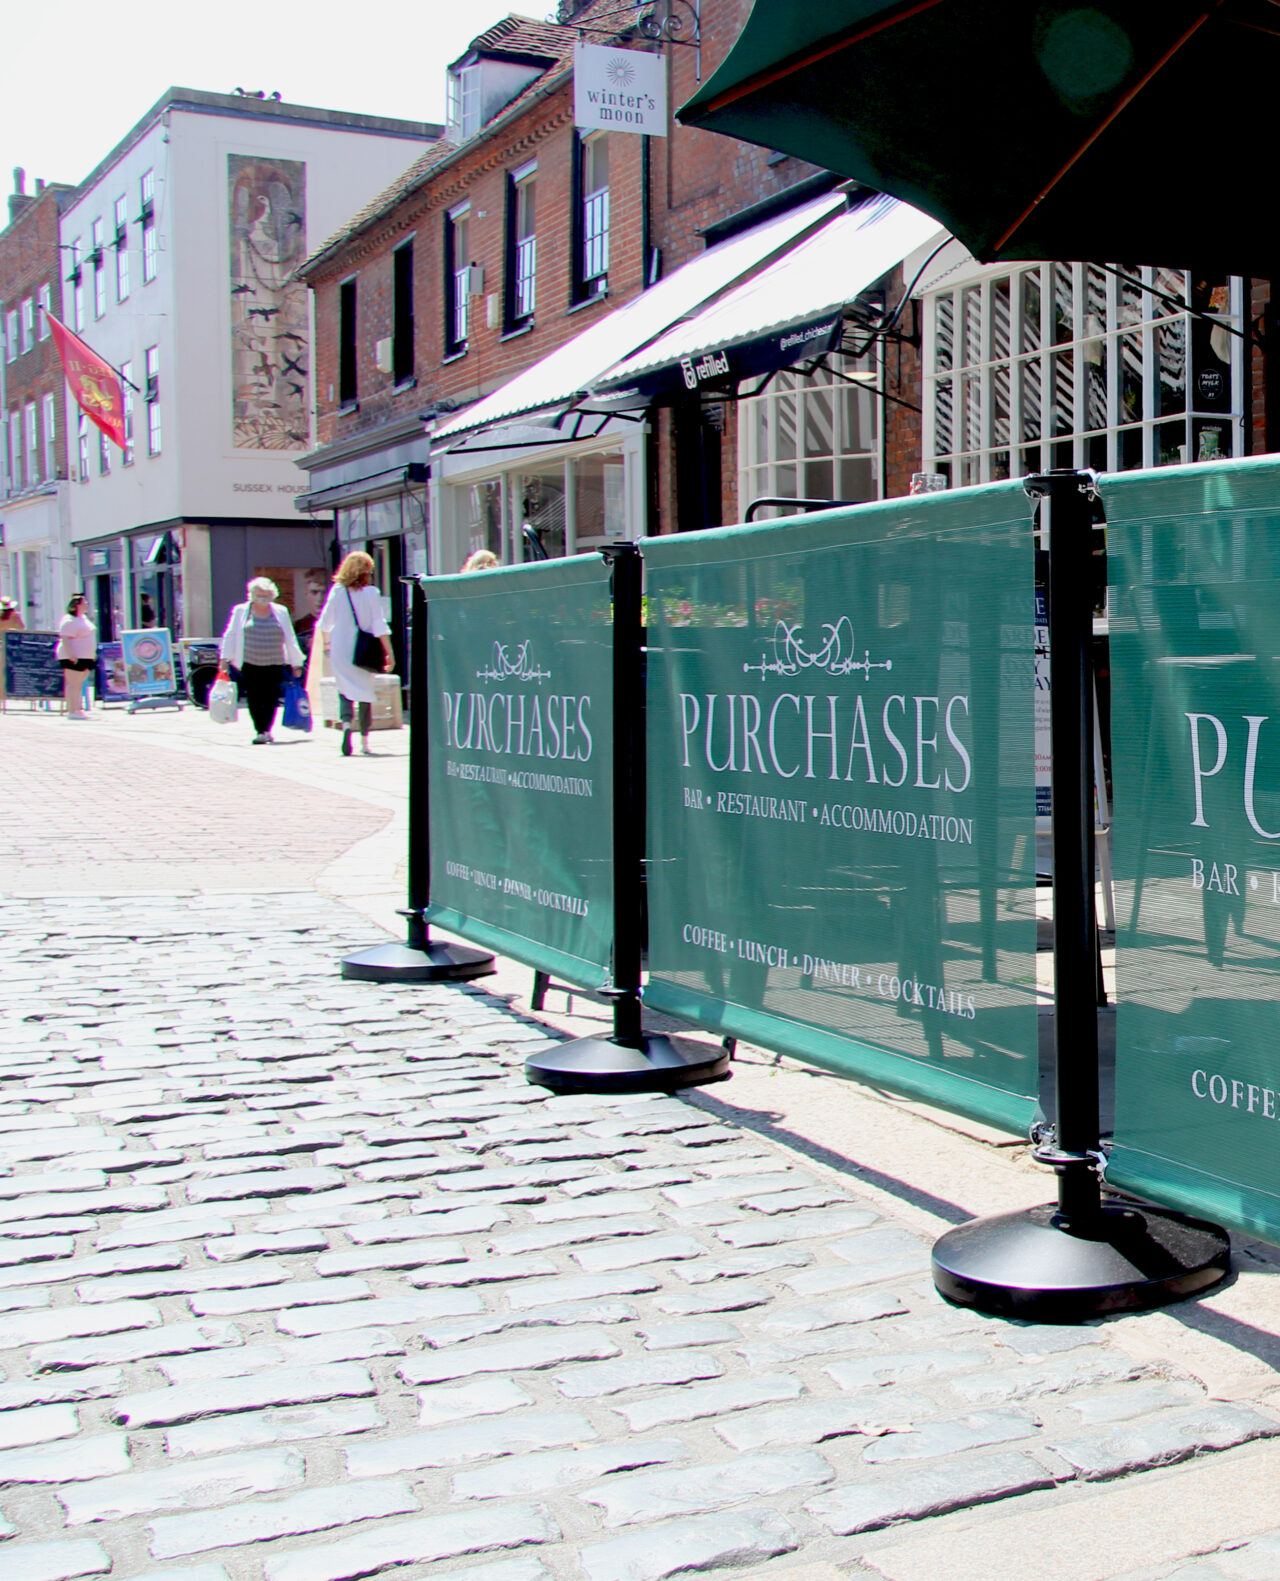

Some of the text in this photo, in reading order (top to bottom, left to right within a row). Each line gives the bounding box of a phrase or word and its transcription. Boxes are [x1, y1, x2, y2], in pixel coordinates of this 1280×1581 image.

[587, 88, 655, 110] winter's
[600, 107, 644, 124] moon
[695, 350, 729, 380] refilled
[232, 483, 272, 493] SUSSEX
[443, 691, 593, 762] PURCHASES
[679, 693, 971, 793] PURCHASES
[512, 771, 593, 797] ACCOMMODATION
[684, 787, 973, 845] BAR RESTAURANT ACCOMMODATION
[1191, 858, 1240, 896] BAR
[537, 888, 589, 917] COCKTAILS
[683, 923, 976, 1019] COFFEE LUNCH DINNER COCKTAILS
